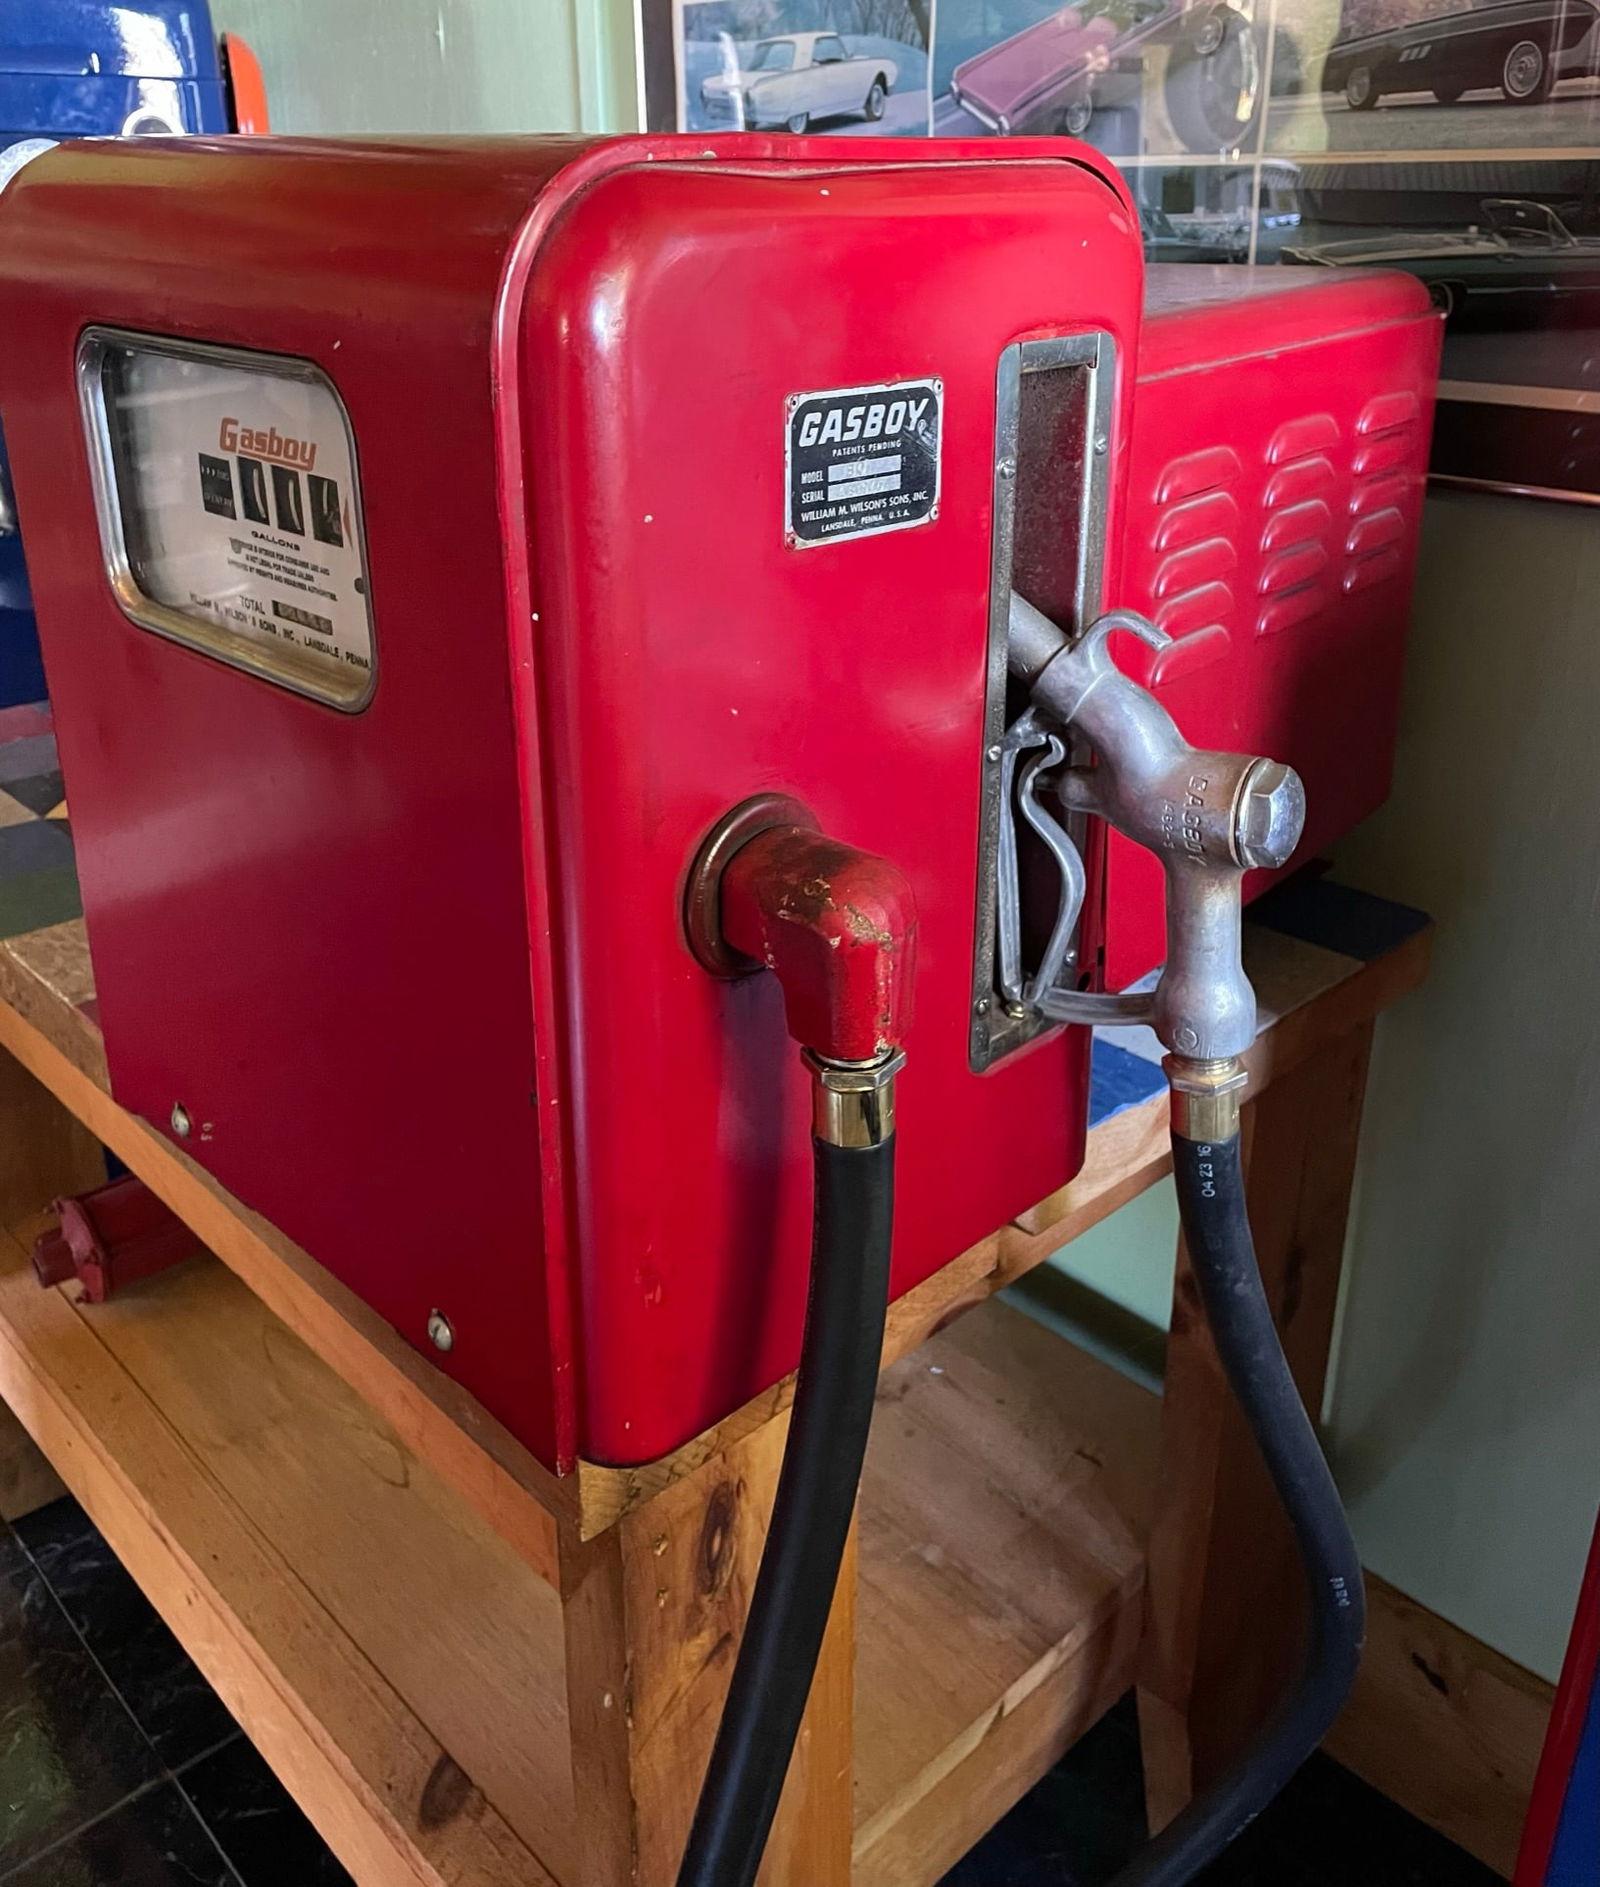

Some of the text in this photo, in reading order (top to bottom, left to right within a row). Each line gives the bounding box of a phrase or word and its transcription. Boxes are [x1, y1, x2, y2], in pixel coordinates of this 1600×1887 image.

[799, 398, 929, 447] GASBOY
[219, 417, 317, 472] Gasboy
[832, 439, 902, 457] PATENTS PENDING
[801, 470, 824, 485] MODEL
[801, 490, 826, 504] SERIAL
[800, 507, 836, 523] WILLIAM
[850, 498, 888, 514] WILSON'S
[251, 530, 301, 551] GALLONS
[239, 595, 266, 615] TOTAL
[1197, 1145, 1216, 1198] 04 23 16
